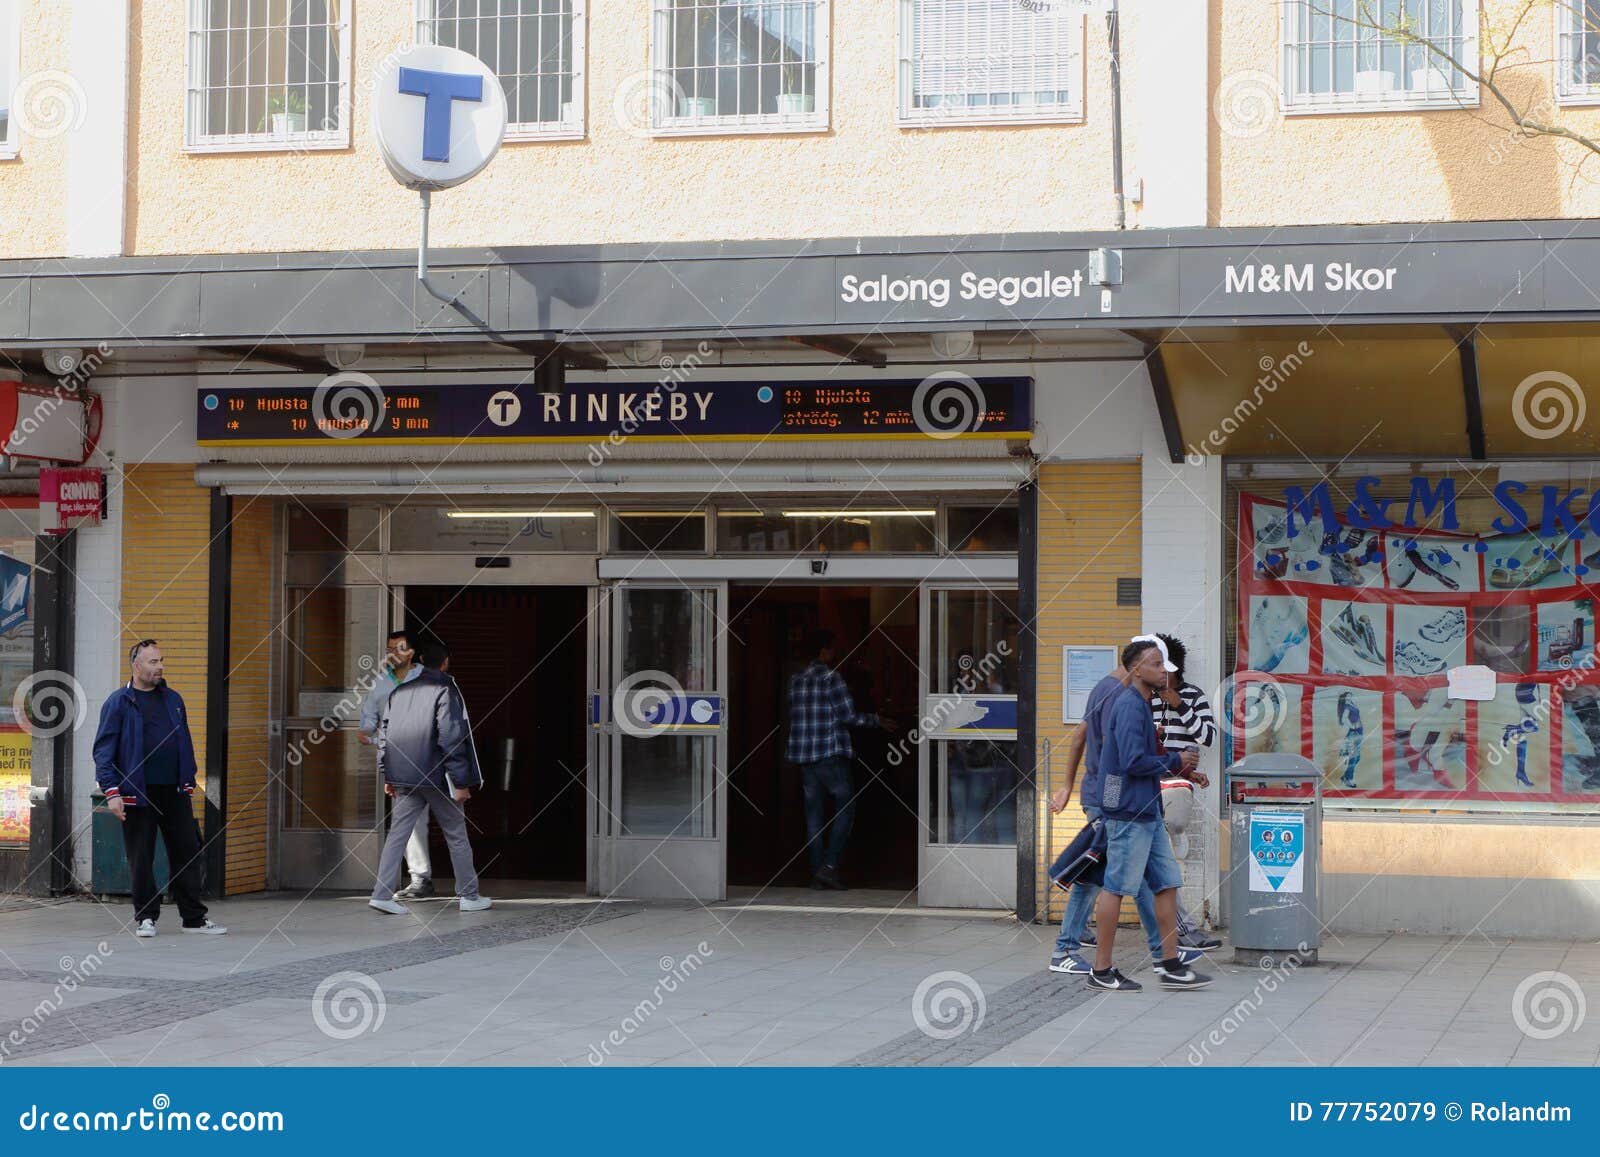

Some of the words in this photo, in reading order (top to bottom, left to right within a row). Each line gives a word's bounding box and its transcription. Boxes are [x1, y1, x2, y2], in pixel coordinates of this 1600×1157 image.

[398, 66, 484, 163] T
[841, 274, 951, 308] Salong
[959, 269, 1083, 306] Segalet
[1224, 263, 1315, 293] M&M
[1324, 261, 1397, 292] Skor
[228, 398, 245, 411] 10
[257, 398, 308, 412] Hjulsta
[397, 397, 420, 408] min
[543, 392, 714, 423] RINKEBY
[291, 418, 307, 430] 10
[318, 418, 369, 431] Hjulsta
[391, 417, 400, 430] 9
[406, 417, 429, 429] min
[1281, 475, 1461, 539] M&M
[1491, 480, 1600, 540] SK
